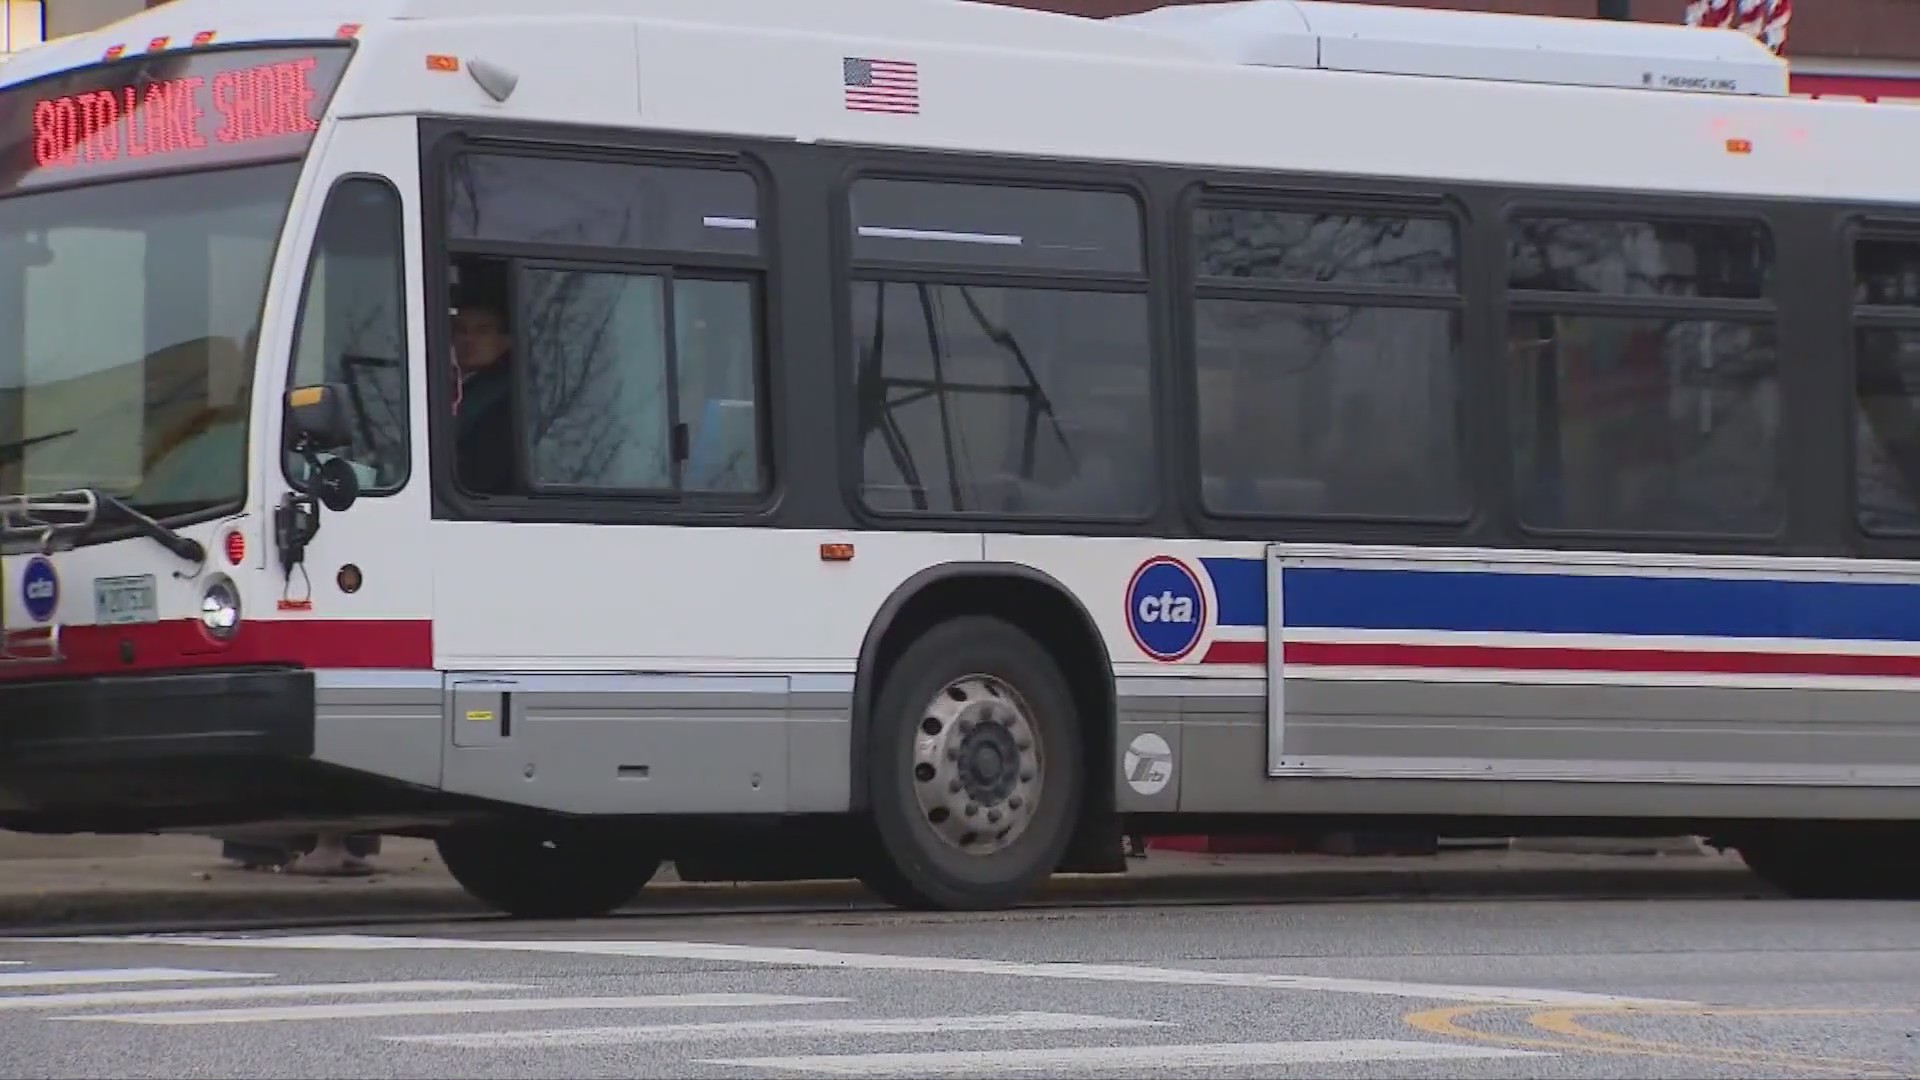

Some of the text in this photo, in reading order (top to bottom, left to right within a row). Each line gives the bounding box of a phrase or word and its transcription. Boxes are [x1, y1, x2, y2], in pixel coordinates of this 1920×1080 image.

[123, 77, 207, 157] LAKE
[212, 57, 319, 144] SHORE
[1139, 590, 1194, 623] cta
